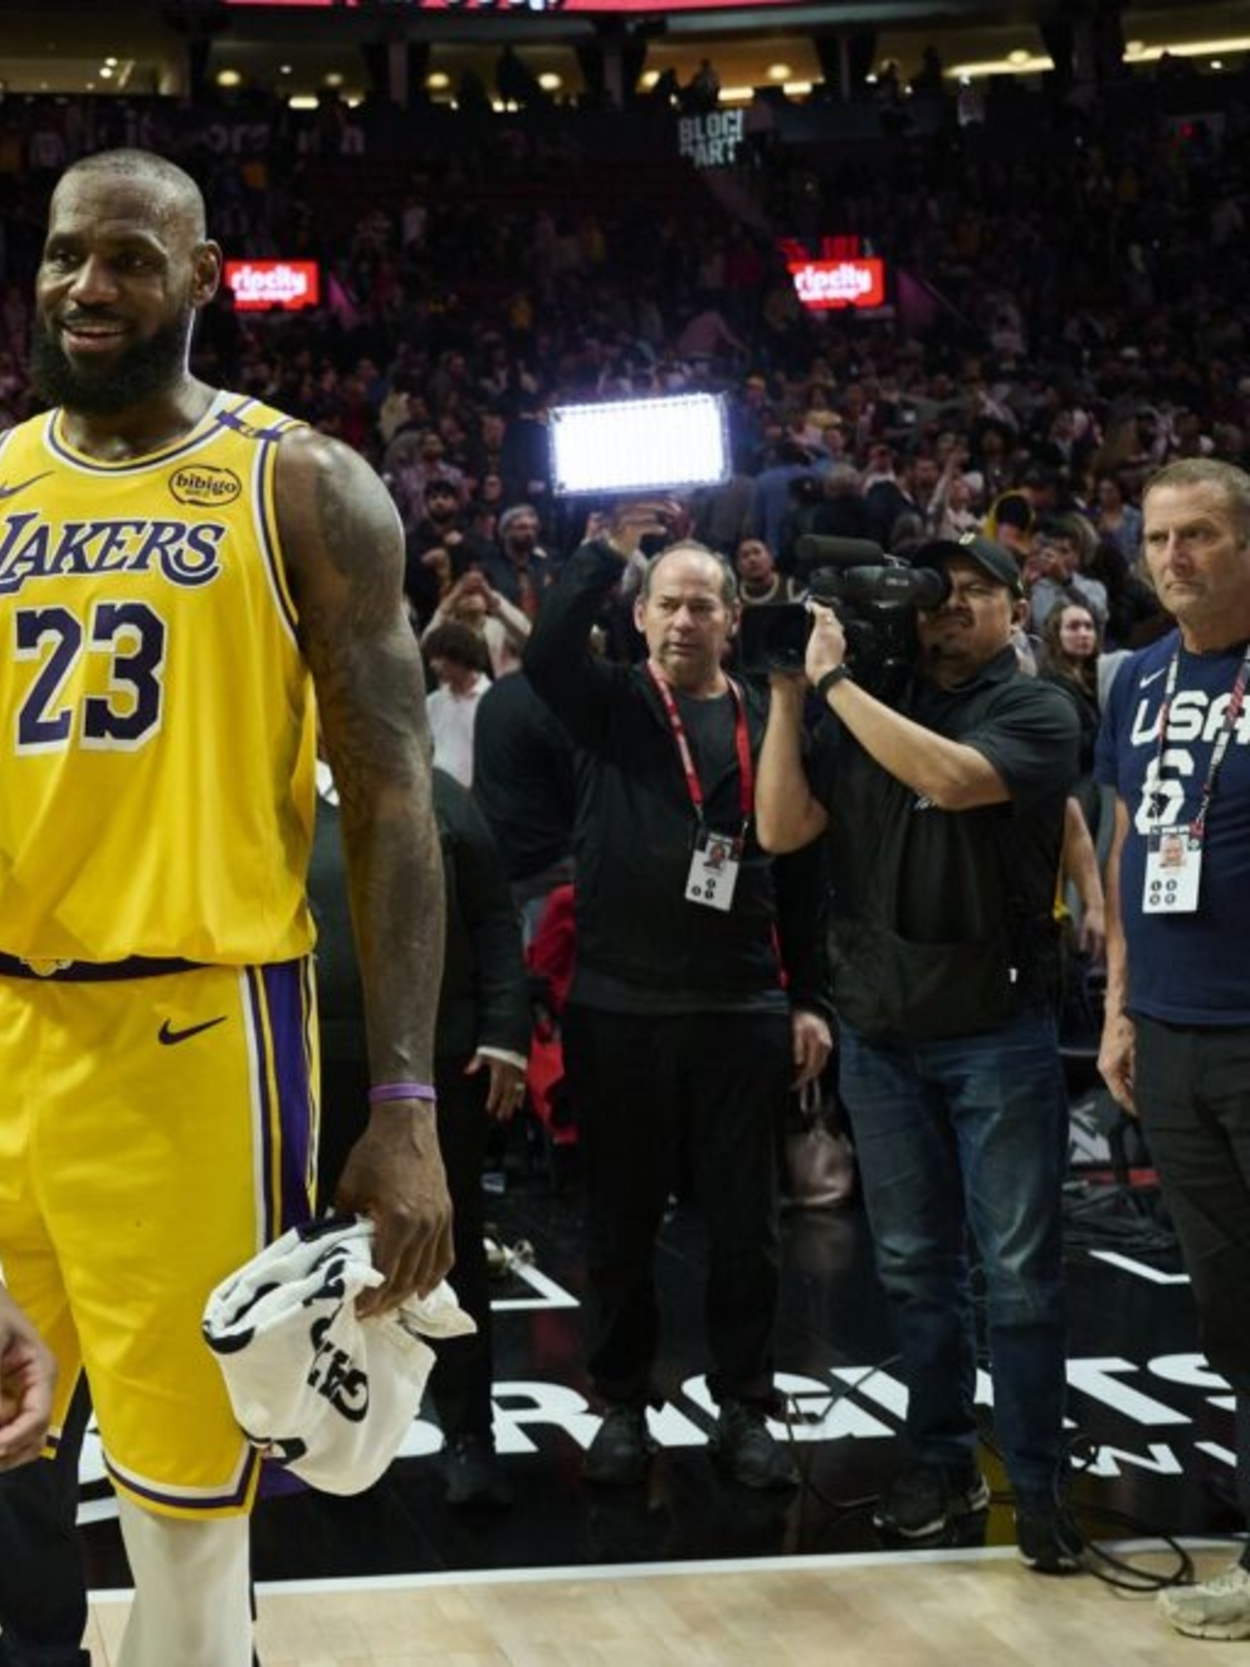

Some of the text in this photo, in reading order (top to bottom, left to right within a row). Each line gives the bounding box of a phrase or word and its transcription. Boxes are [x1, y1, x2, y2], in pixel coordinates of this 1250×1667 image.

[176, 473, 238, 496] bibigo
[14, 601, 167, 757] 23
[1130, 690, 1250, 747] USA
[1134, 748, 1195, 836] 6
